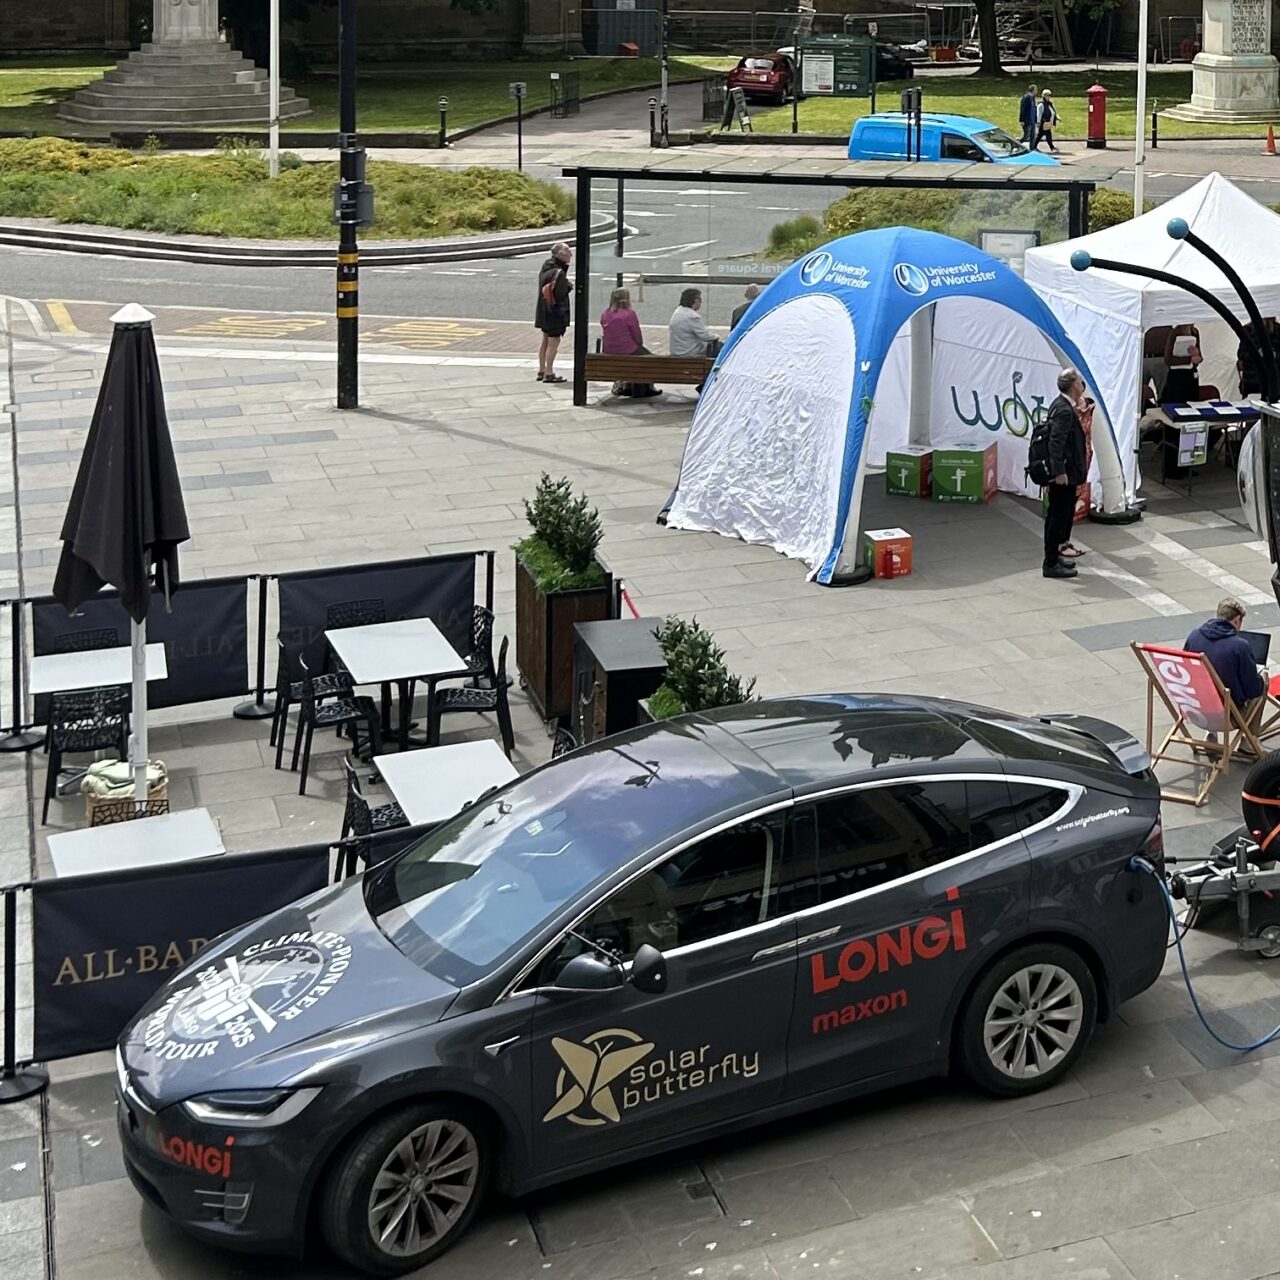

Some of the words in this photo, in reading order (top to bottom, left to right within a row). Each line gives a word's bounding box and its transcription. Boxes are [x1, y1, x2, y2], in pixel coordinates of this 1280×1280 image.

[831, 260, 871, 278] University
[924, 263, 979, 277] University
[825, 273, 832, 282] of
[833, 274, 871, 289] Worcester
[931, 277, 942, 288] of
[943, 270, 997, 286] Worcester
[811, 987, 908, 1033] maxon
[155, 1040, 219, 1061] TOUR
[629, 1044, 711, 1085] solar
[623, 1049, 760, 1110] butterfly
